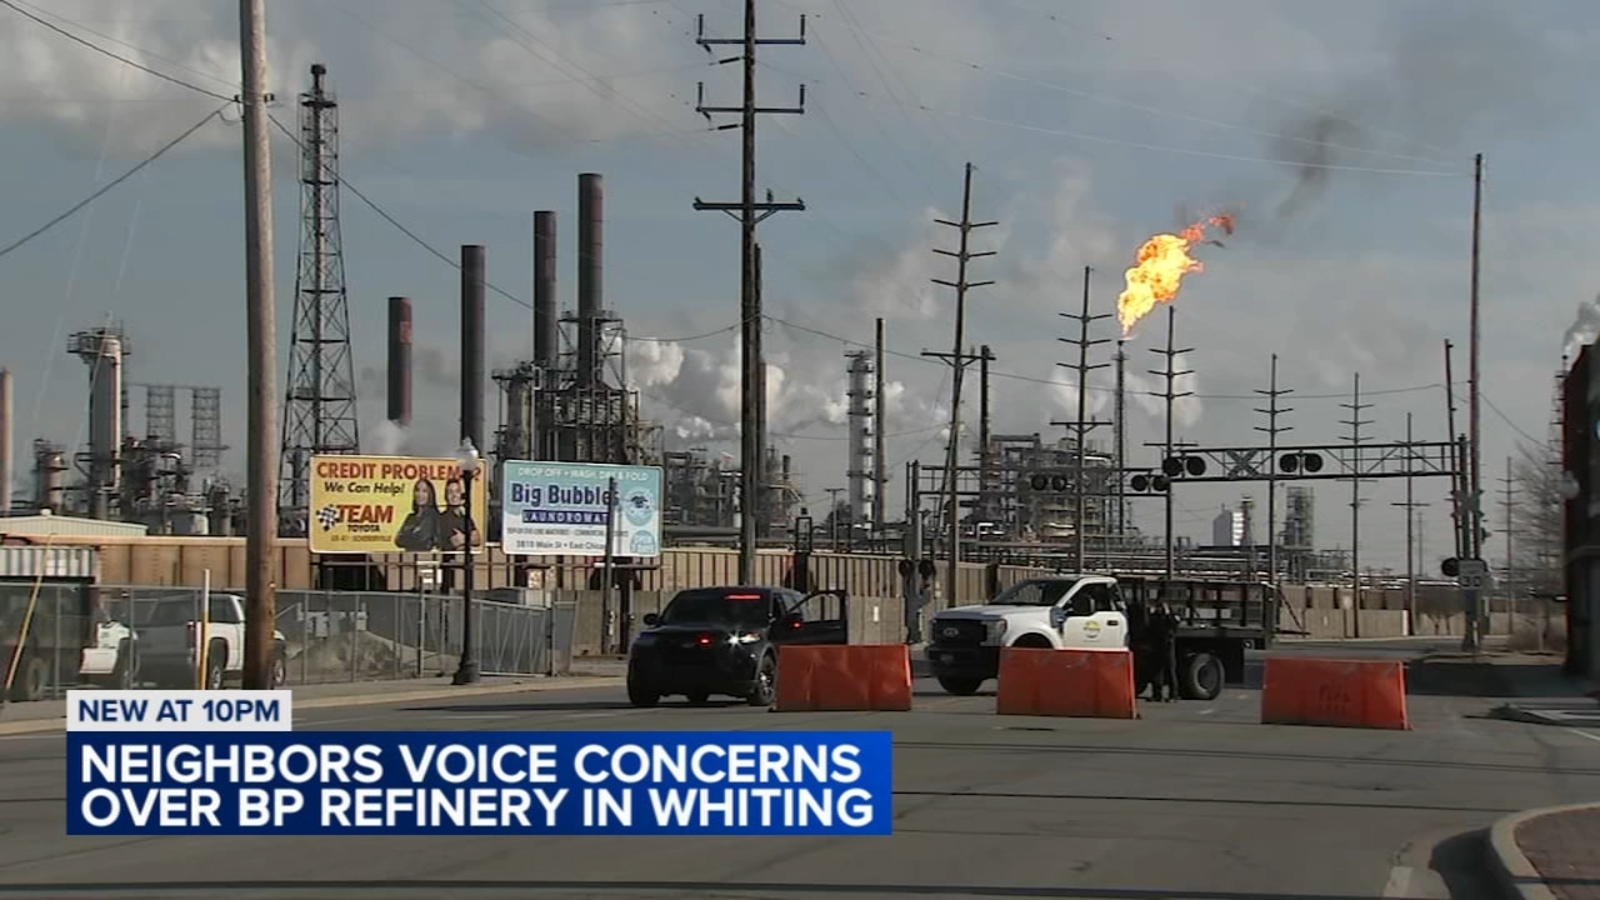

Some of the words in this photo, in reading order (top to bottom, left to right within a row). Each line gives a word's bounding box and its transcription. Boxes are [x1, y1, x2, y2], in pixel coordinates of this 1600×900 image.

[317, 462, 376, 479] CREDIT
[382, 463, 482, 482] PROBLEM?
[325, 482, 344, 492] We
[348, 483, 370, 493] Can
[374, 483, 405, 496] Help!
[511, 483, 541, 507] Big
[336, 504, 394, 523] TEAM
[347, 524, 380, 533] TOYOTA
